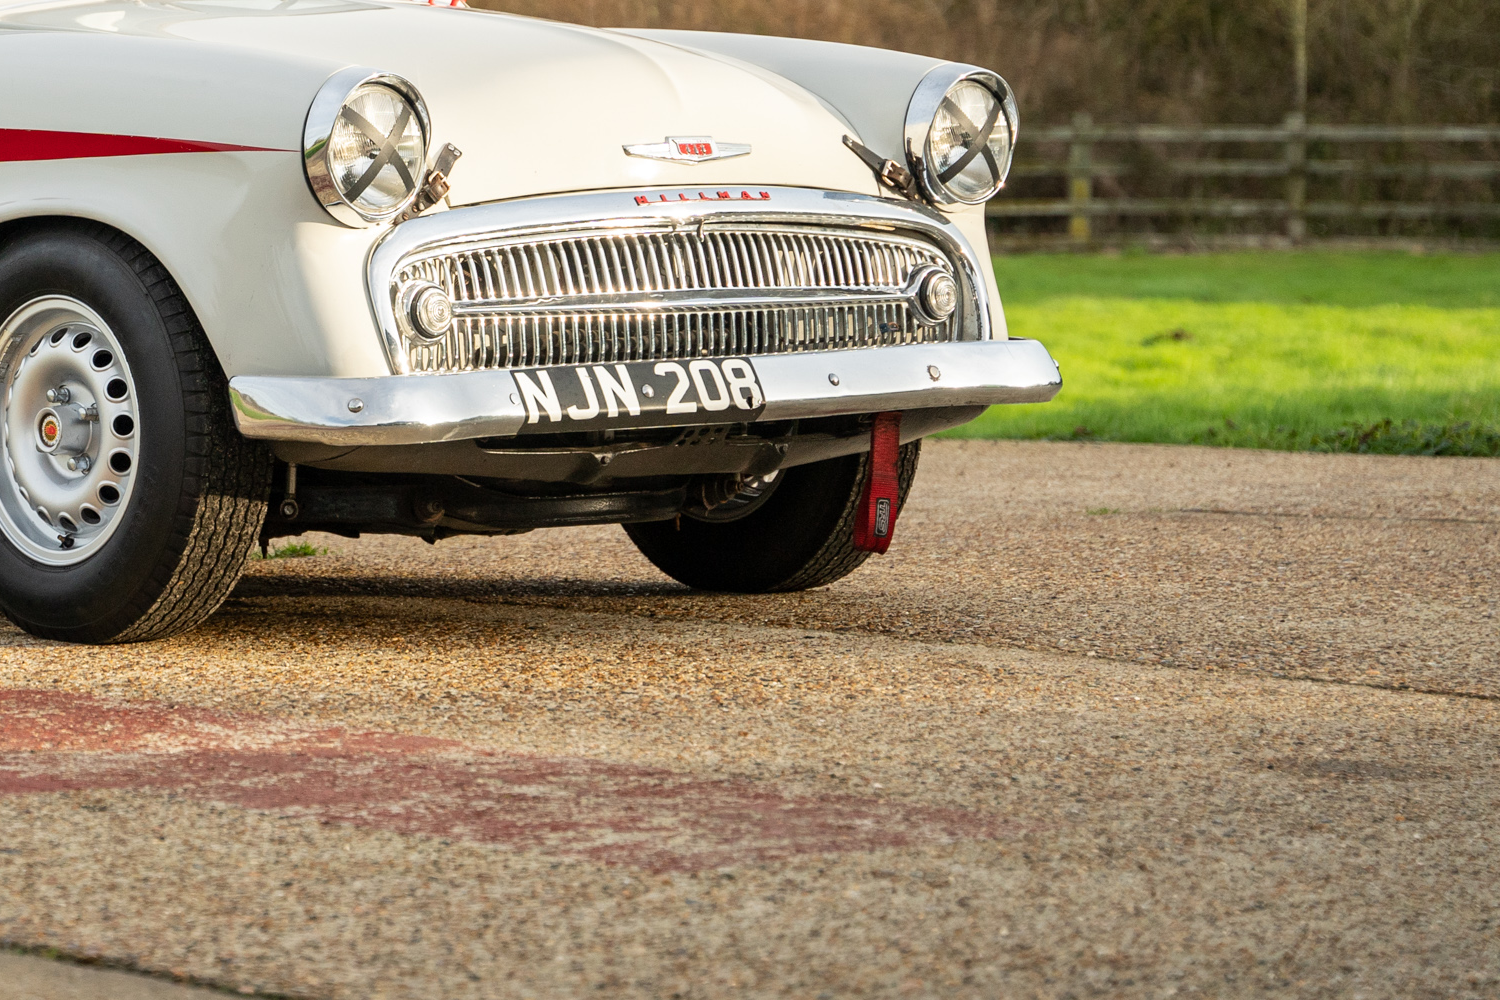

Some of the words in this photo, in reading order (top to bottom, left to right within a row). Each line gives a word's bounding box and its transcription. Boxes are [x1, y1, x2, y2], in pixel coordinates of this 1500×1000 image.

[634, 190, 771, 206] HILLMAN
[514, 364, 641, 424] NJN
[654, 359, 762, 415] 208
